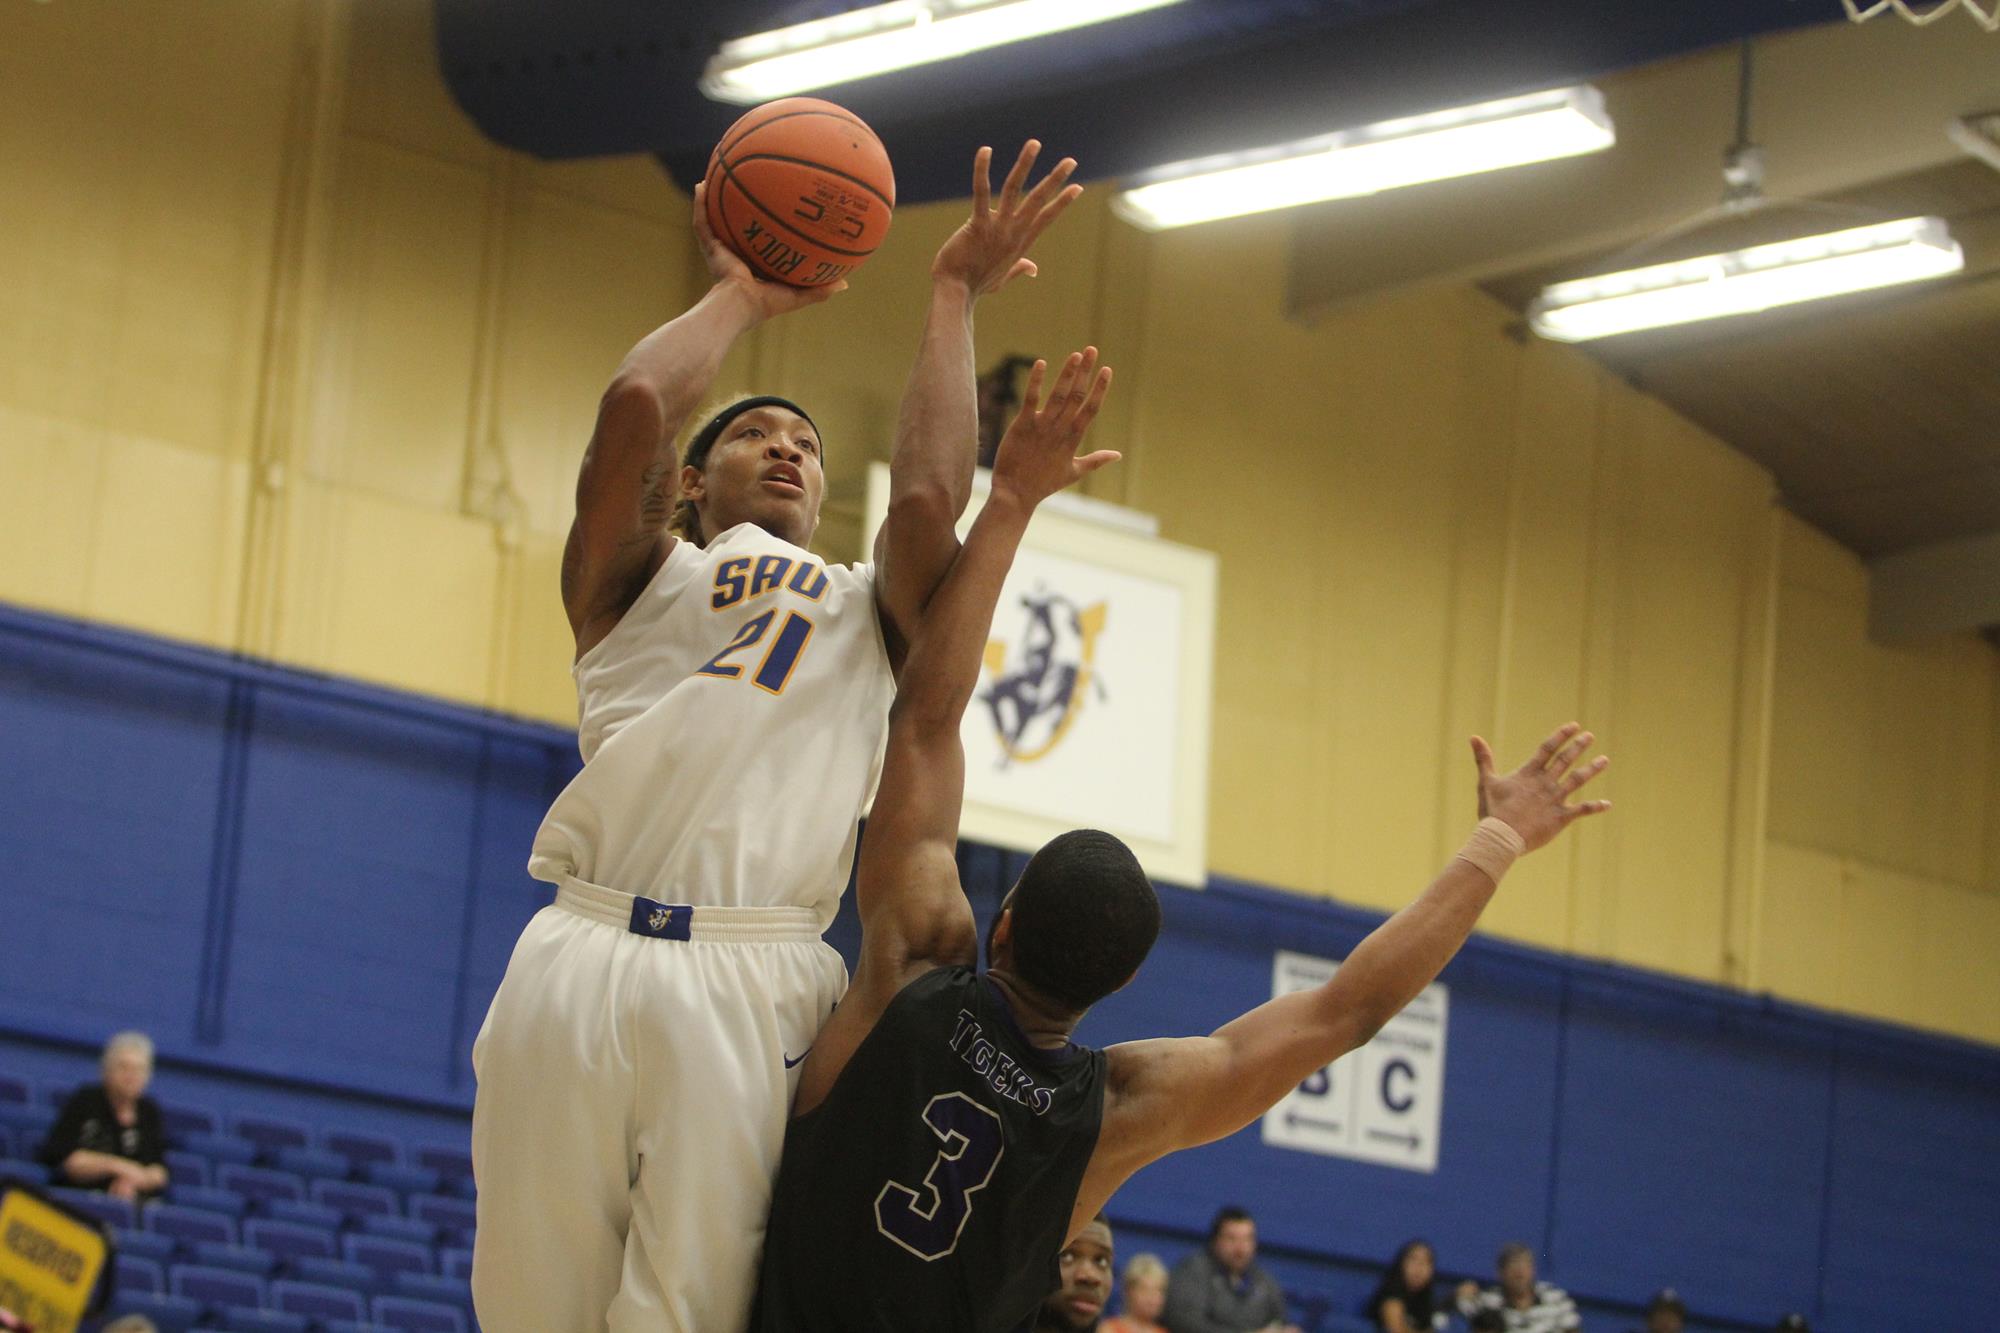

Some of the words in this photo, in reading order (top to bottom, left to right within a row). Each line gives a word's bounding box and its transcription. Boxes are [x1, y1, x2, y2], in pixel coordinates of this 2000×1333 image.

[743, 220, 808, 276] ROCK
[711, 554, 832, 613] SAU
[695, 606, 815, 696] 21
[949, 1008, 1057, 1116] TIGERS
[1379, 1057, 1416, 1114] C
[874, 1091, 1005, 1262] 3
